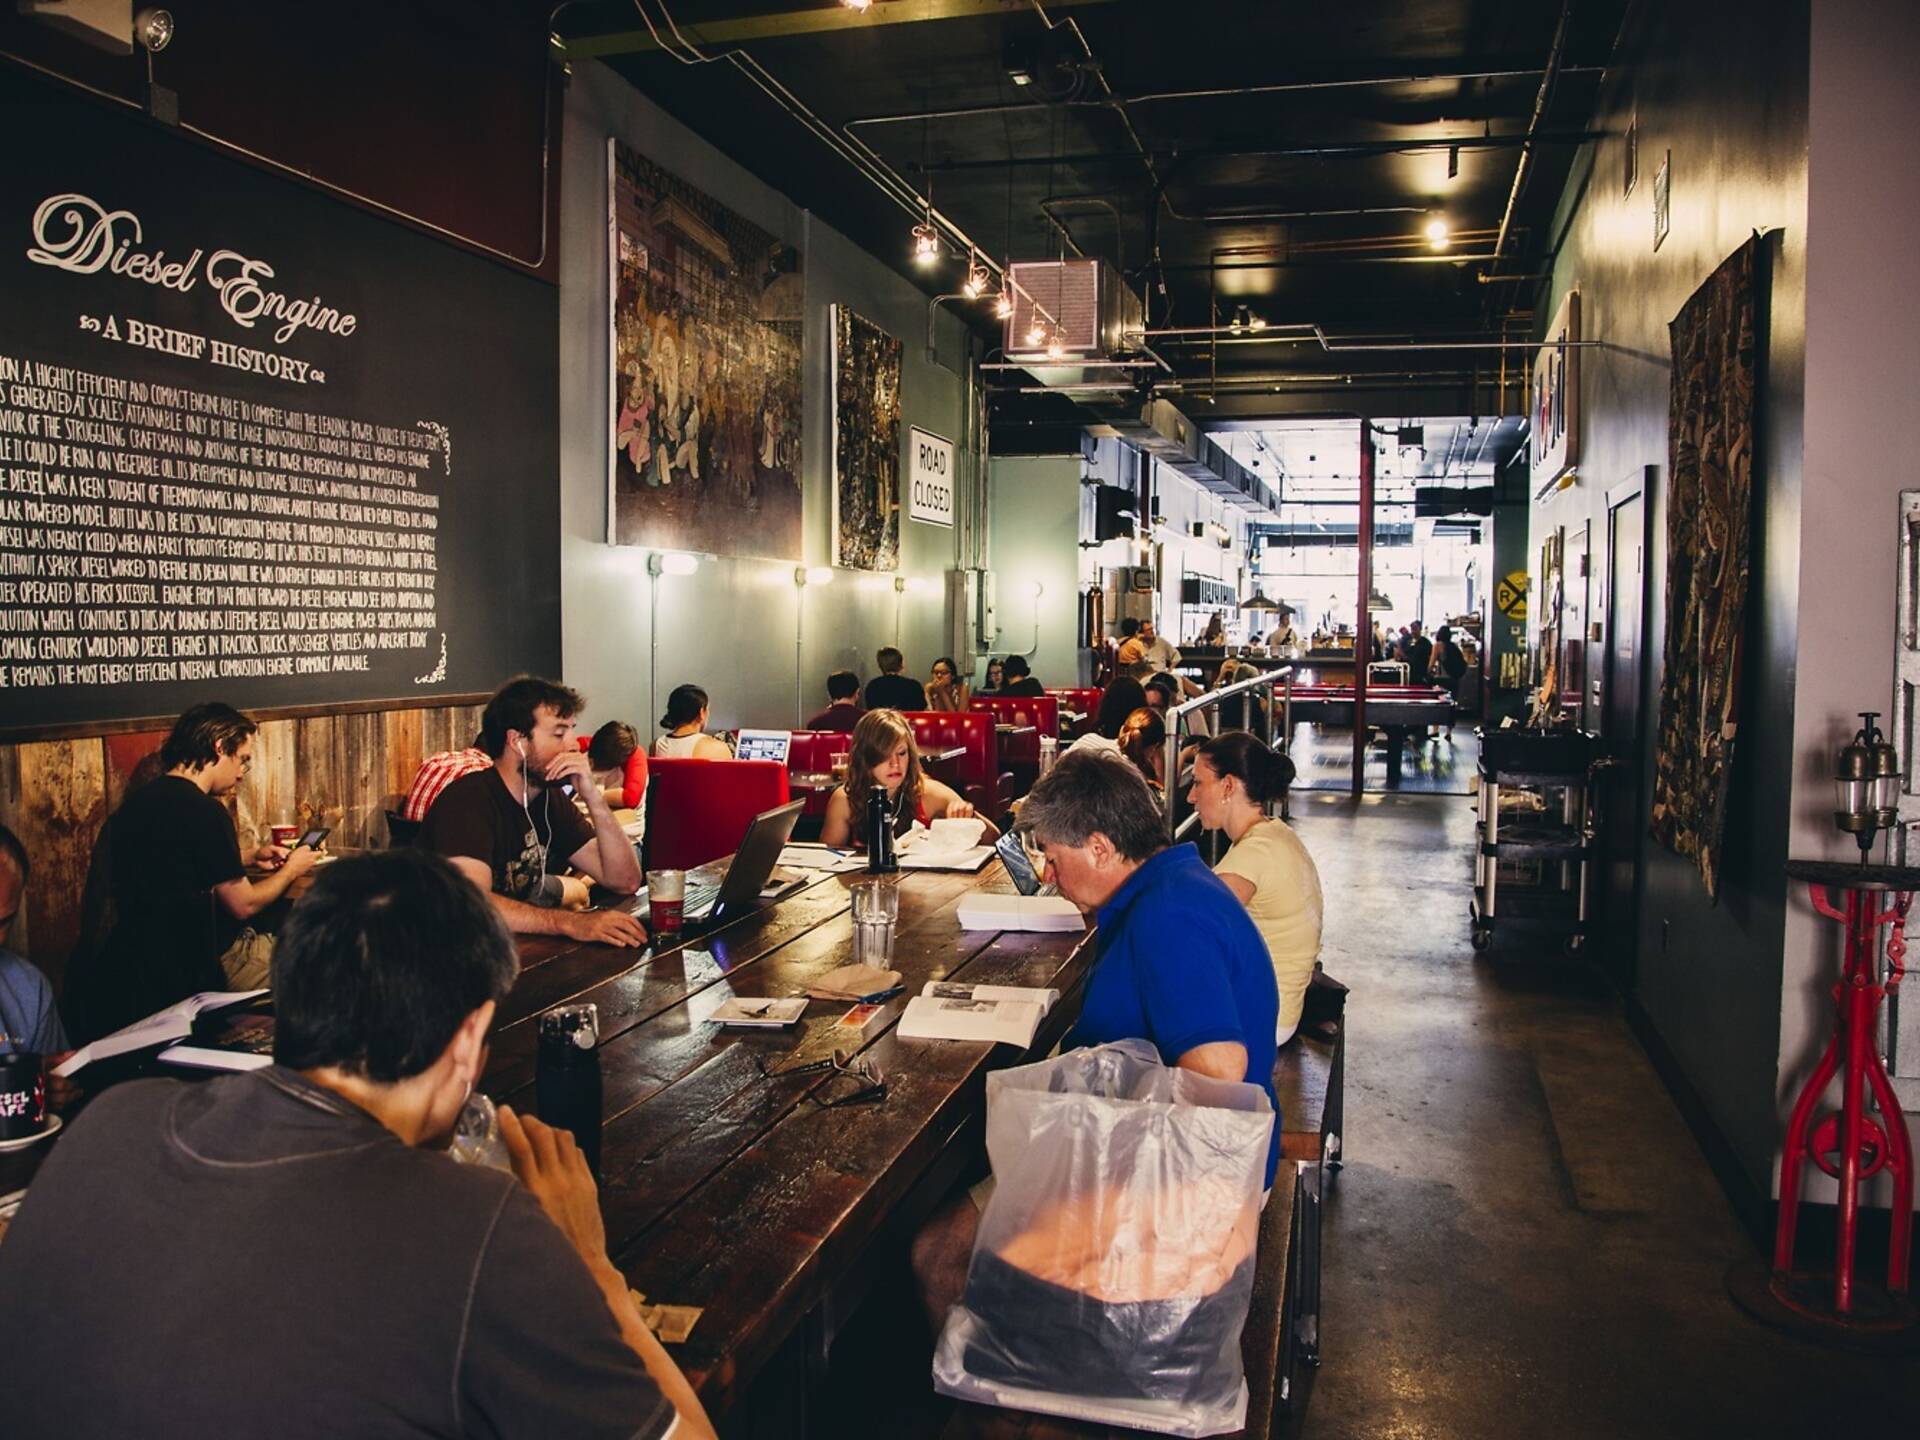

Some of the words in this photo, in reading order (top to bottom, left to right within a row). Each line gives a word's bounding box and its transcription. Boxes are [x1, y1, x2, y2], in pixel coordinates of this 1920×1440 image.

[26, 193, 203, 293] Diesel
[207, 249, 357, 344] Engine
[102, 315, 122, 340] A
[126, 318, 207, 360] BRIEF
[210, 340, 311, 384] HISTORY
[23, 360, 32, 387] A
[35, 363, 74, 394] HIGHLY
[76, 371, 126, 402] EFFICIENT
[129, 380, 148, 403] AND
[150, 384, 187, 410] COMPACT
[190, 391, 218, 415] ENGINE
[220, 397, 238, 420] ABLE
[240, 400, 250, 421] TO
[251, 403, 283, 427] COMPETE
[284, 410, 302, 431] WITH
[304, 412, 317, 433] THE
[10, 385, 72, 415] GENERATED
[72, 395, 84, 417] AT
[88, 397, 124, 423] SCALES
[126, 403, 182, 432] ATTAINABLE
[186, 414, 206, 435] ONLY
[210, 418, 220, 438] BY
[223, 419, 236, 440] THE
[239, 423, 262, 444] LARGE
[350, 441, 372, 461] DIESEL
[27, 413, 40, 436] OF
[42, 415, 62, 439] THE
[64, 418, 125, 448] STRUGGLING
[129, 428, 182, 454] CRAFTSMAN
[185, 438, 202, 457] AND
[239, 447, 248, 464] OF
[251, 446, 263, 466] THE
[14, 438, 21, 462] IT
[24, 439, 56, 466] COULD
[59, 444, 71, 468] BE
[72, 446, 94, 469] RUN
[96, 450, 110, 471] ON
[112, 451, 160, 477] VEGETABLE
[177, 460, 188, 481] ITS
[190, 462, 236, 486] DEVELOPMENT
[239, 469, 254, 488] AND
[256, 471, 287, 492] ULTIMATE
[919, 443, 946, 475] ROAD
[10, 467, 45, 494] DIESEL
[45, 472, 66, 496] WAS
[69, 475, 77, 497] A
[79, 475, 104, 500] KEEN
[108, 479, 145, 503] STUDENT
[148, 483, 160, 504] OF
[160, 484, 231, 511] THERMODYNAMICS
[234, 492, 248, 512] AND
[250, 494, 290, 516] PASSIONATE
[914, 480, 951, 512] CLOSED
[24, 500, 70, 525] POWERED
[109, 506, 124, 529] BUT
[126, 507, 134, 530] IT
[135, 509, 154, 531] WAS
[155, 510, 165, 532] TO
[167, 511, 179, 533] BE
[180, 513, 194, 534] HIS
[266, 520, 291, 540] ENGINE
[292, 522, 306, 542] THAT
[24, 528, 46, 549] WAS
[46, 529, 82, 551] NEARLY
[86, 531, 115, 553] KILLED
[116, 533, 141, 553] WHEN
[143, 535, 156, 555] AN
[158, 535, 182, 556] EARLY
[184, 536, 228, 558] PROTOTYPE
[298, 544, 312, 563] THIS
[36, 554, 45, 576] A
[81, 556, 110, 578] DIESEL
[110, 558, 145, 578] WORKED
[146, 559, 157, 579] TO
[158, 560, 188, 581] REFINE
[189, 562, 202, 581] HIS
[229, 564, 248, 583] UNTIL
[20, 580, 72, 604] OPERATED
[74, 582, 90, 603] HIS
[90, 583, 113, 604] FIRST
[115, 583, 158, 604] SUCCESSFUL
[163, 585, 194, 606] ENGINE
[196, 586, 214, 606] FROM
[216, 586, 233, 605] THAT
[235, 586, 256, 606] POINT
[258, 587, 288, 607] FORWARD
[289, 588, 300, 607] THE
[368, 591, 380, 608] SEE
[40, 610, 73, 631] WHICH
[78, 609, 128, 631] CONTINUES
[130, 610, 139, 629] TO
[140, 609, 158, 630] THIS
[178, 610, 208, 630] DURING
[210, 611, 222, 630] HIS
[224, 610, 258, 630] LIFETIME
[259, 611, 280, 630] DIESEL
[281, 612, 306, 630] WOULD
[306, 612, 318, 630] SEE
[39, 636, 82, 659] CENTURY
[85, 636, 116, 657] WOULD
[118, 636, 139, 657] FIND
[141, 635, 169, 656] DIESEL
[172, 635, 206, 655] ENGINES
[208, 636, 218, 654] IN
[288, 634, 329, 652] PASSENGER
[12, 665, 54, 687] REMAINS
[56, 664, 74, 685] THE
[76, 664, 97, 684] MOST
[100, 663, 133, 684] ENERGY
[135, 662, 176, 682] EFFICIENT
[179, 660, 218, 681] INTERNAL
[219, 658, 264, 678] COMBUSTION
[266, 656, 293, 676] ENGINE
